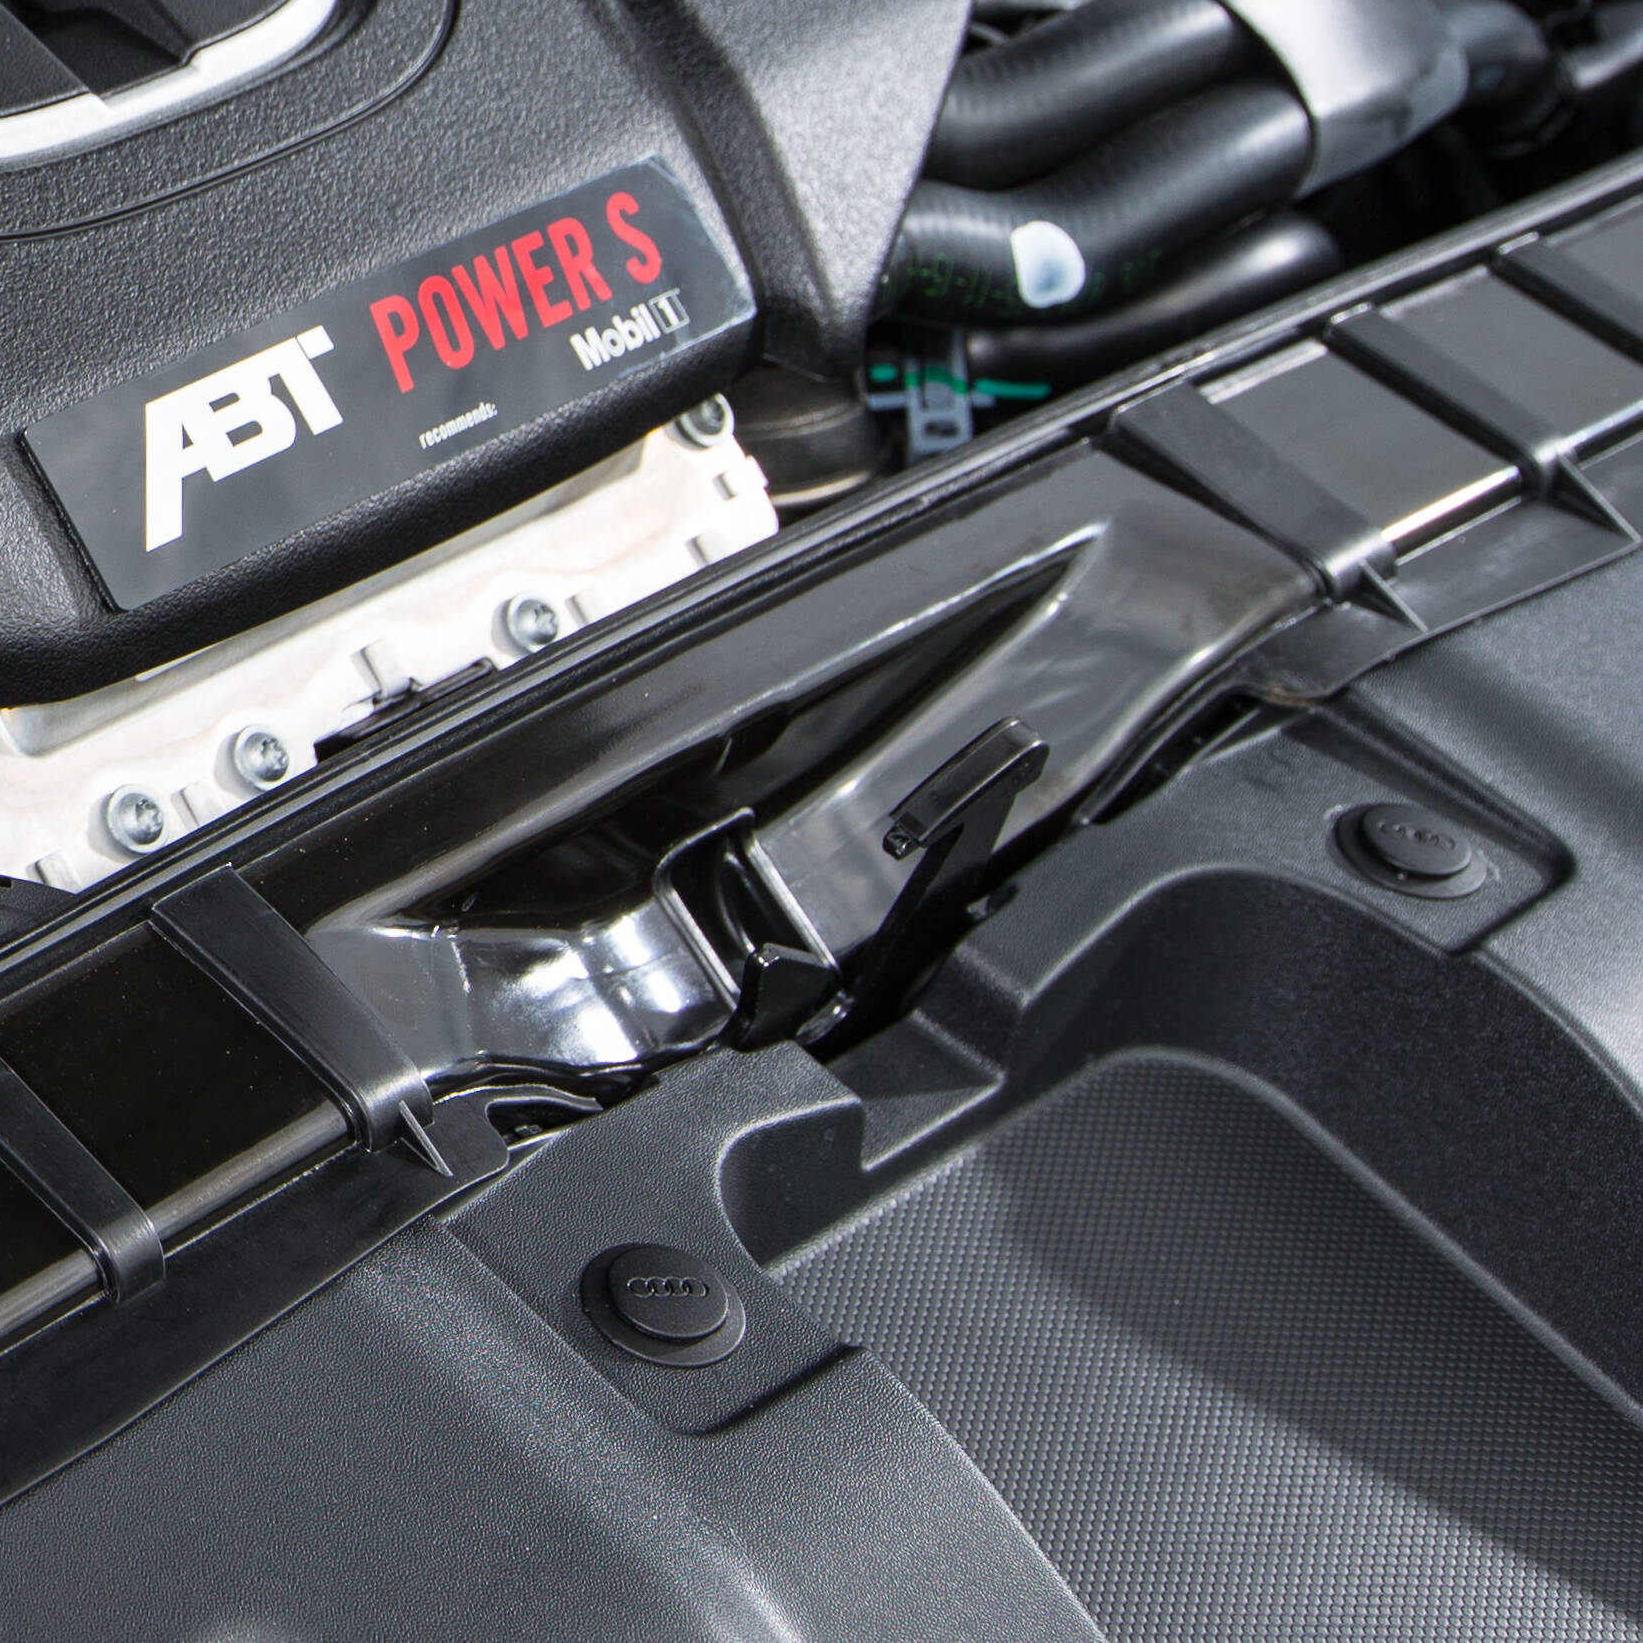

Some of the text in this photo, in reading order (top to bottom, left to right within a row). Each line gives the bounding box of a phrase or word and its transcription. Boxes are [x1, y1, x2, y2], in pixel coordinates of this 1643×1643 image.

[370, 191, 662, 393] POWER S
[570, 305, 659, 370] Mobil
[145, 324, 344, 552] ABT
